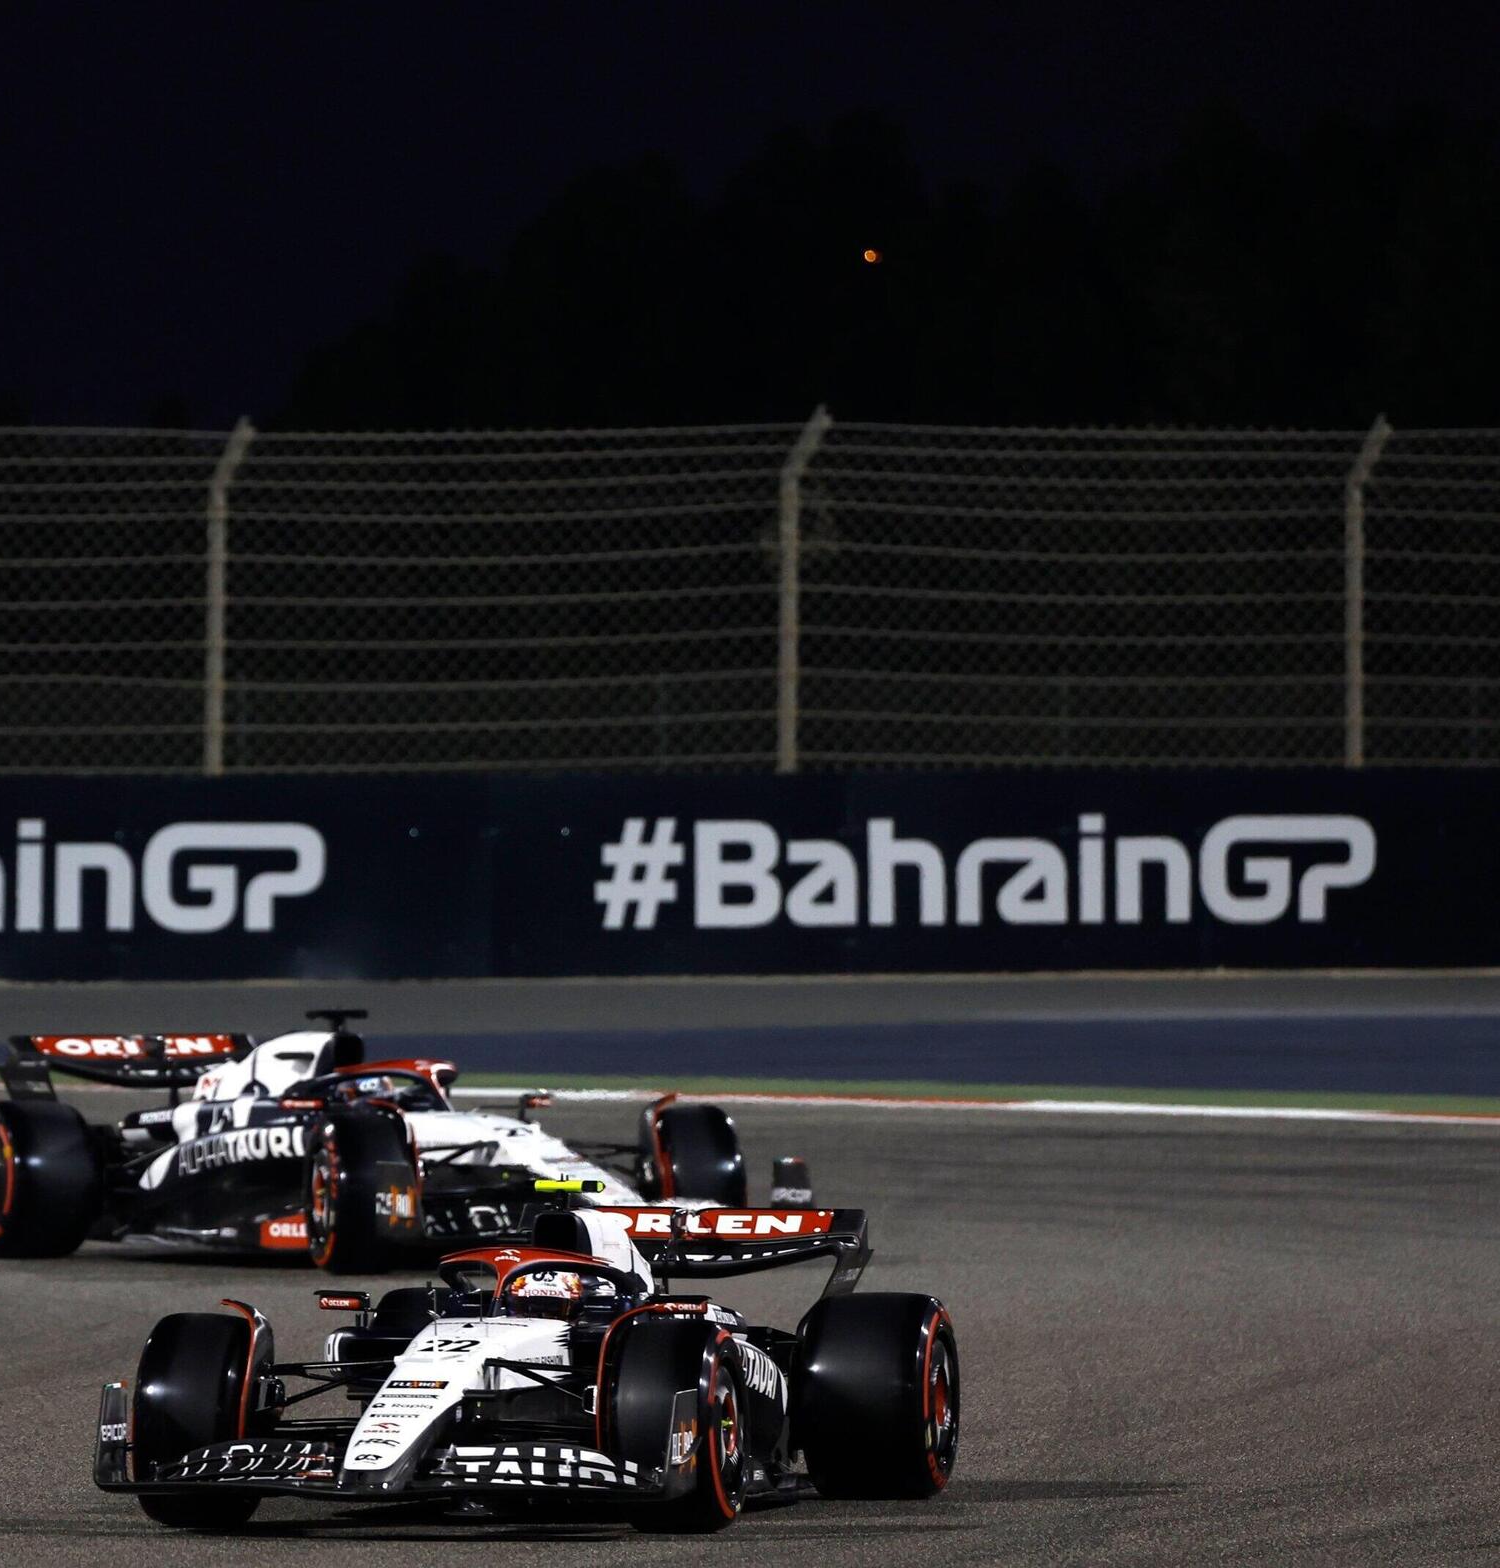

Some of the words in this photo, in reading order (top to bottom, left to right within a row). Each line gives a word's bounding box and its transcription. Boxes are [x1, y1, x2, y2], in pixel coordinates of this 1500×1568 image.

[594, 813, 1377, 929] #BahrainGP
[525, 1289, 565, 1299] HONDA
[417, 1340, 480, 1352] 22
